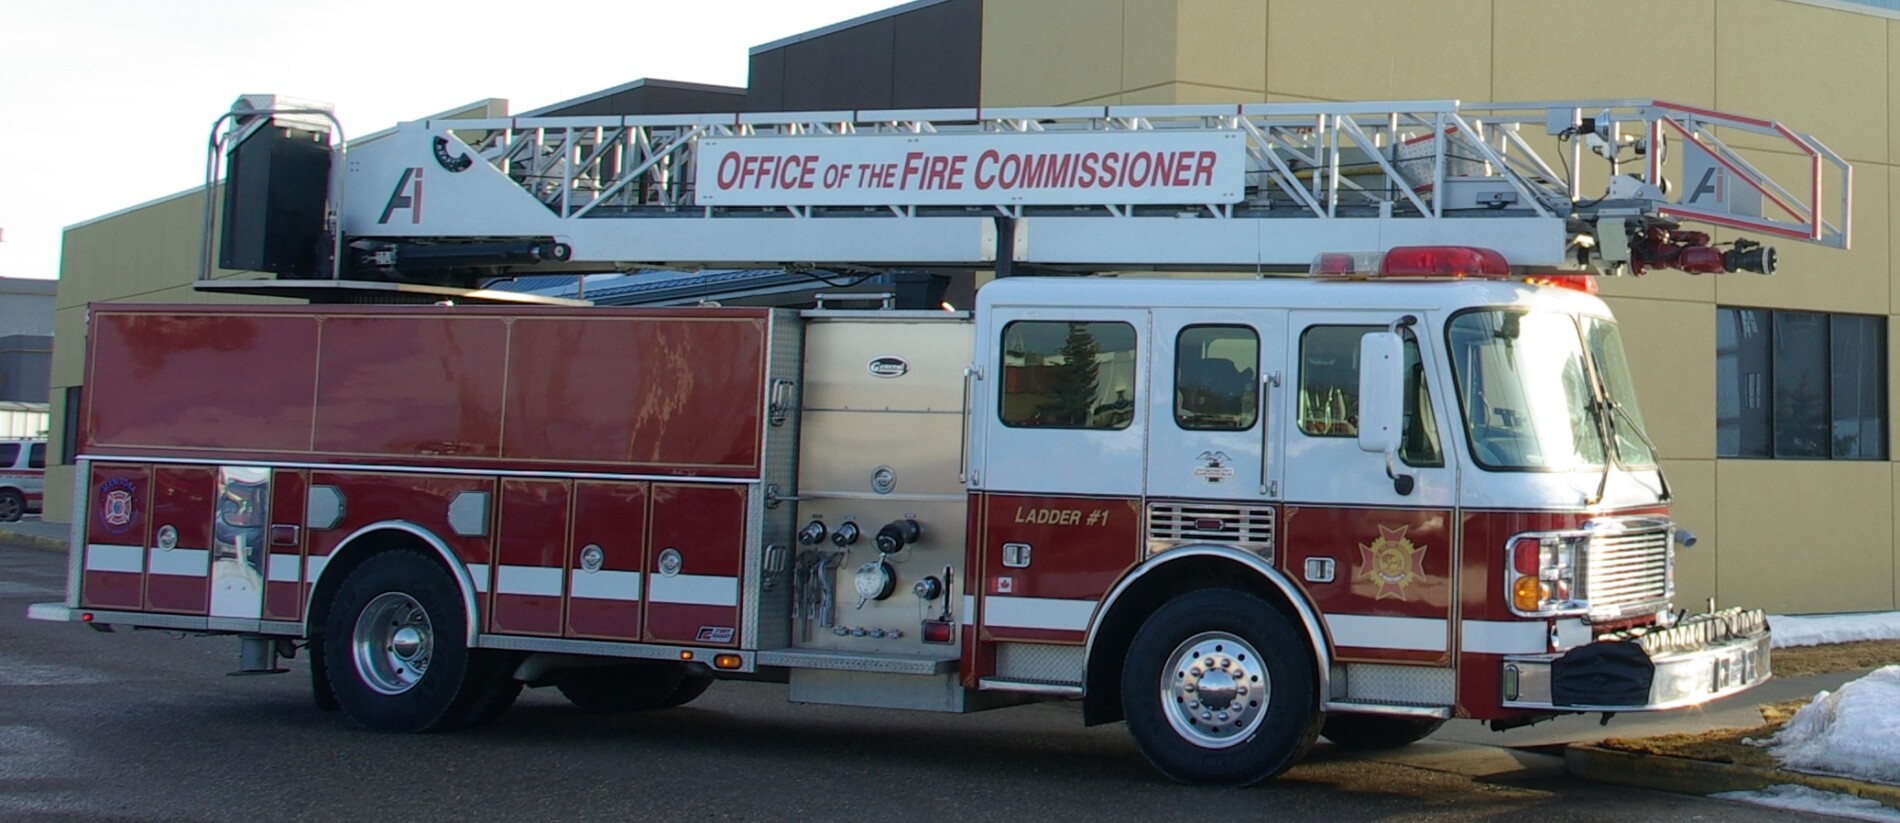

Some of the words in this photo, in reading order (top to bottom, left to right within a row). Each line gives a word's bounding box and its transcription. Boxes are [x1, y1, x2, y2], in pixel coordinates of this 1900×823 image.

[717, 151, 819, 190] OFFICE
[823, 164, 852, 189] OF
[857, 163, 898, 188] THE
[900, 152, 968, 190] FIRE
[974, 149, 1217, 190] COMMISSIONER
[1015, 506, 1082, 525] LADDER
[1086, 510, 1109, 526] #1
